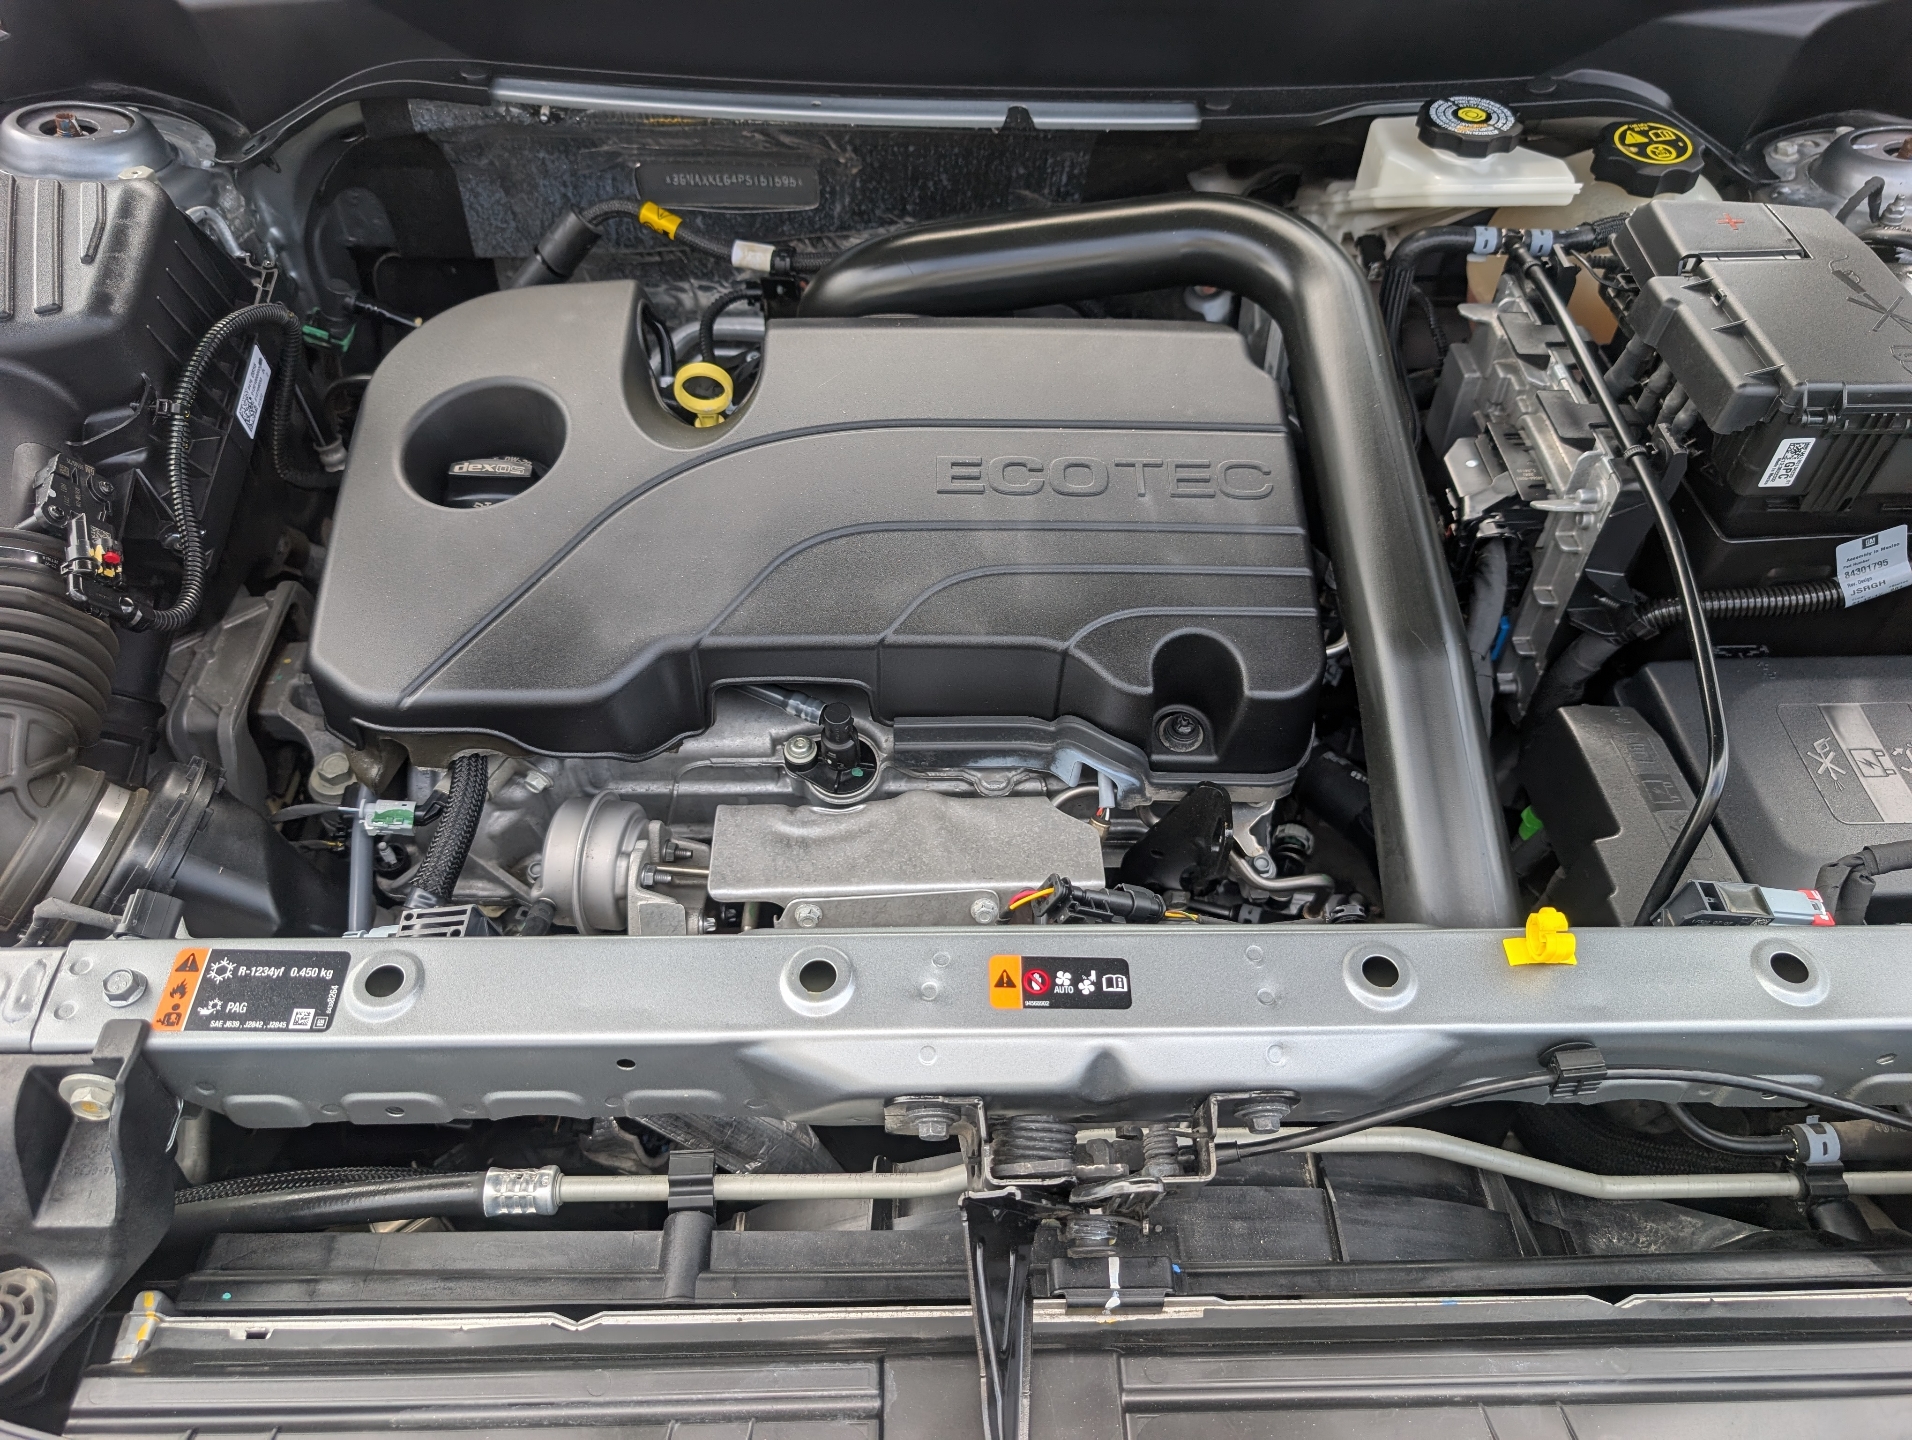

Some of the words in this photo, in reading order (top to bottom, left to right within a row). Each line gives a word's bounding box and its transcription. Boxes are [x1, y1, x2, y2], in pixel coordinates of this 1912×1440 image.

[453, 462, 526, 475] dexos
[1778, 462, 1796, 479] GPC
[935, 455, 1274, 501] ECOTEC
[238, 966, 285, 978] R-1234yf
[290, 967, 318, 977] 0.450
[319, 967, 334, 979] kg
[1054, 986, 1074, 994] AUTO
[226, 1002, 247, 1013] PAG
[210, 1020, 224, 1028] SAE
